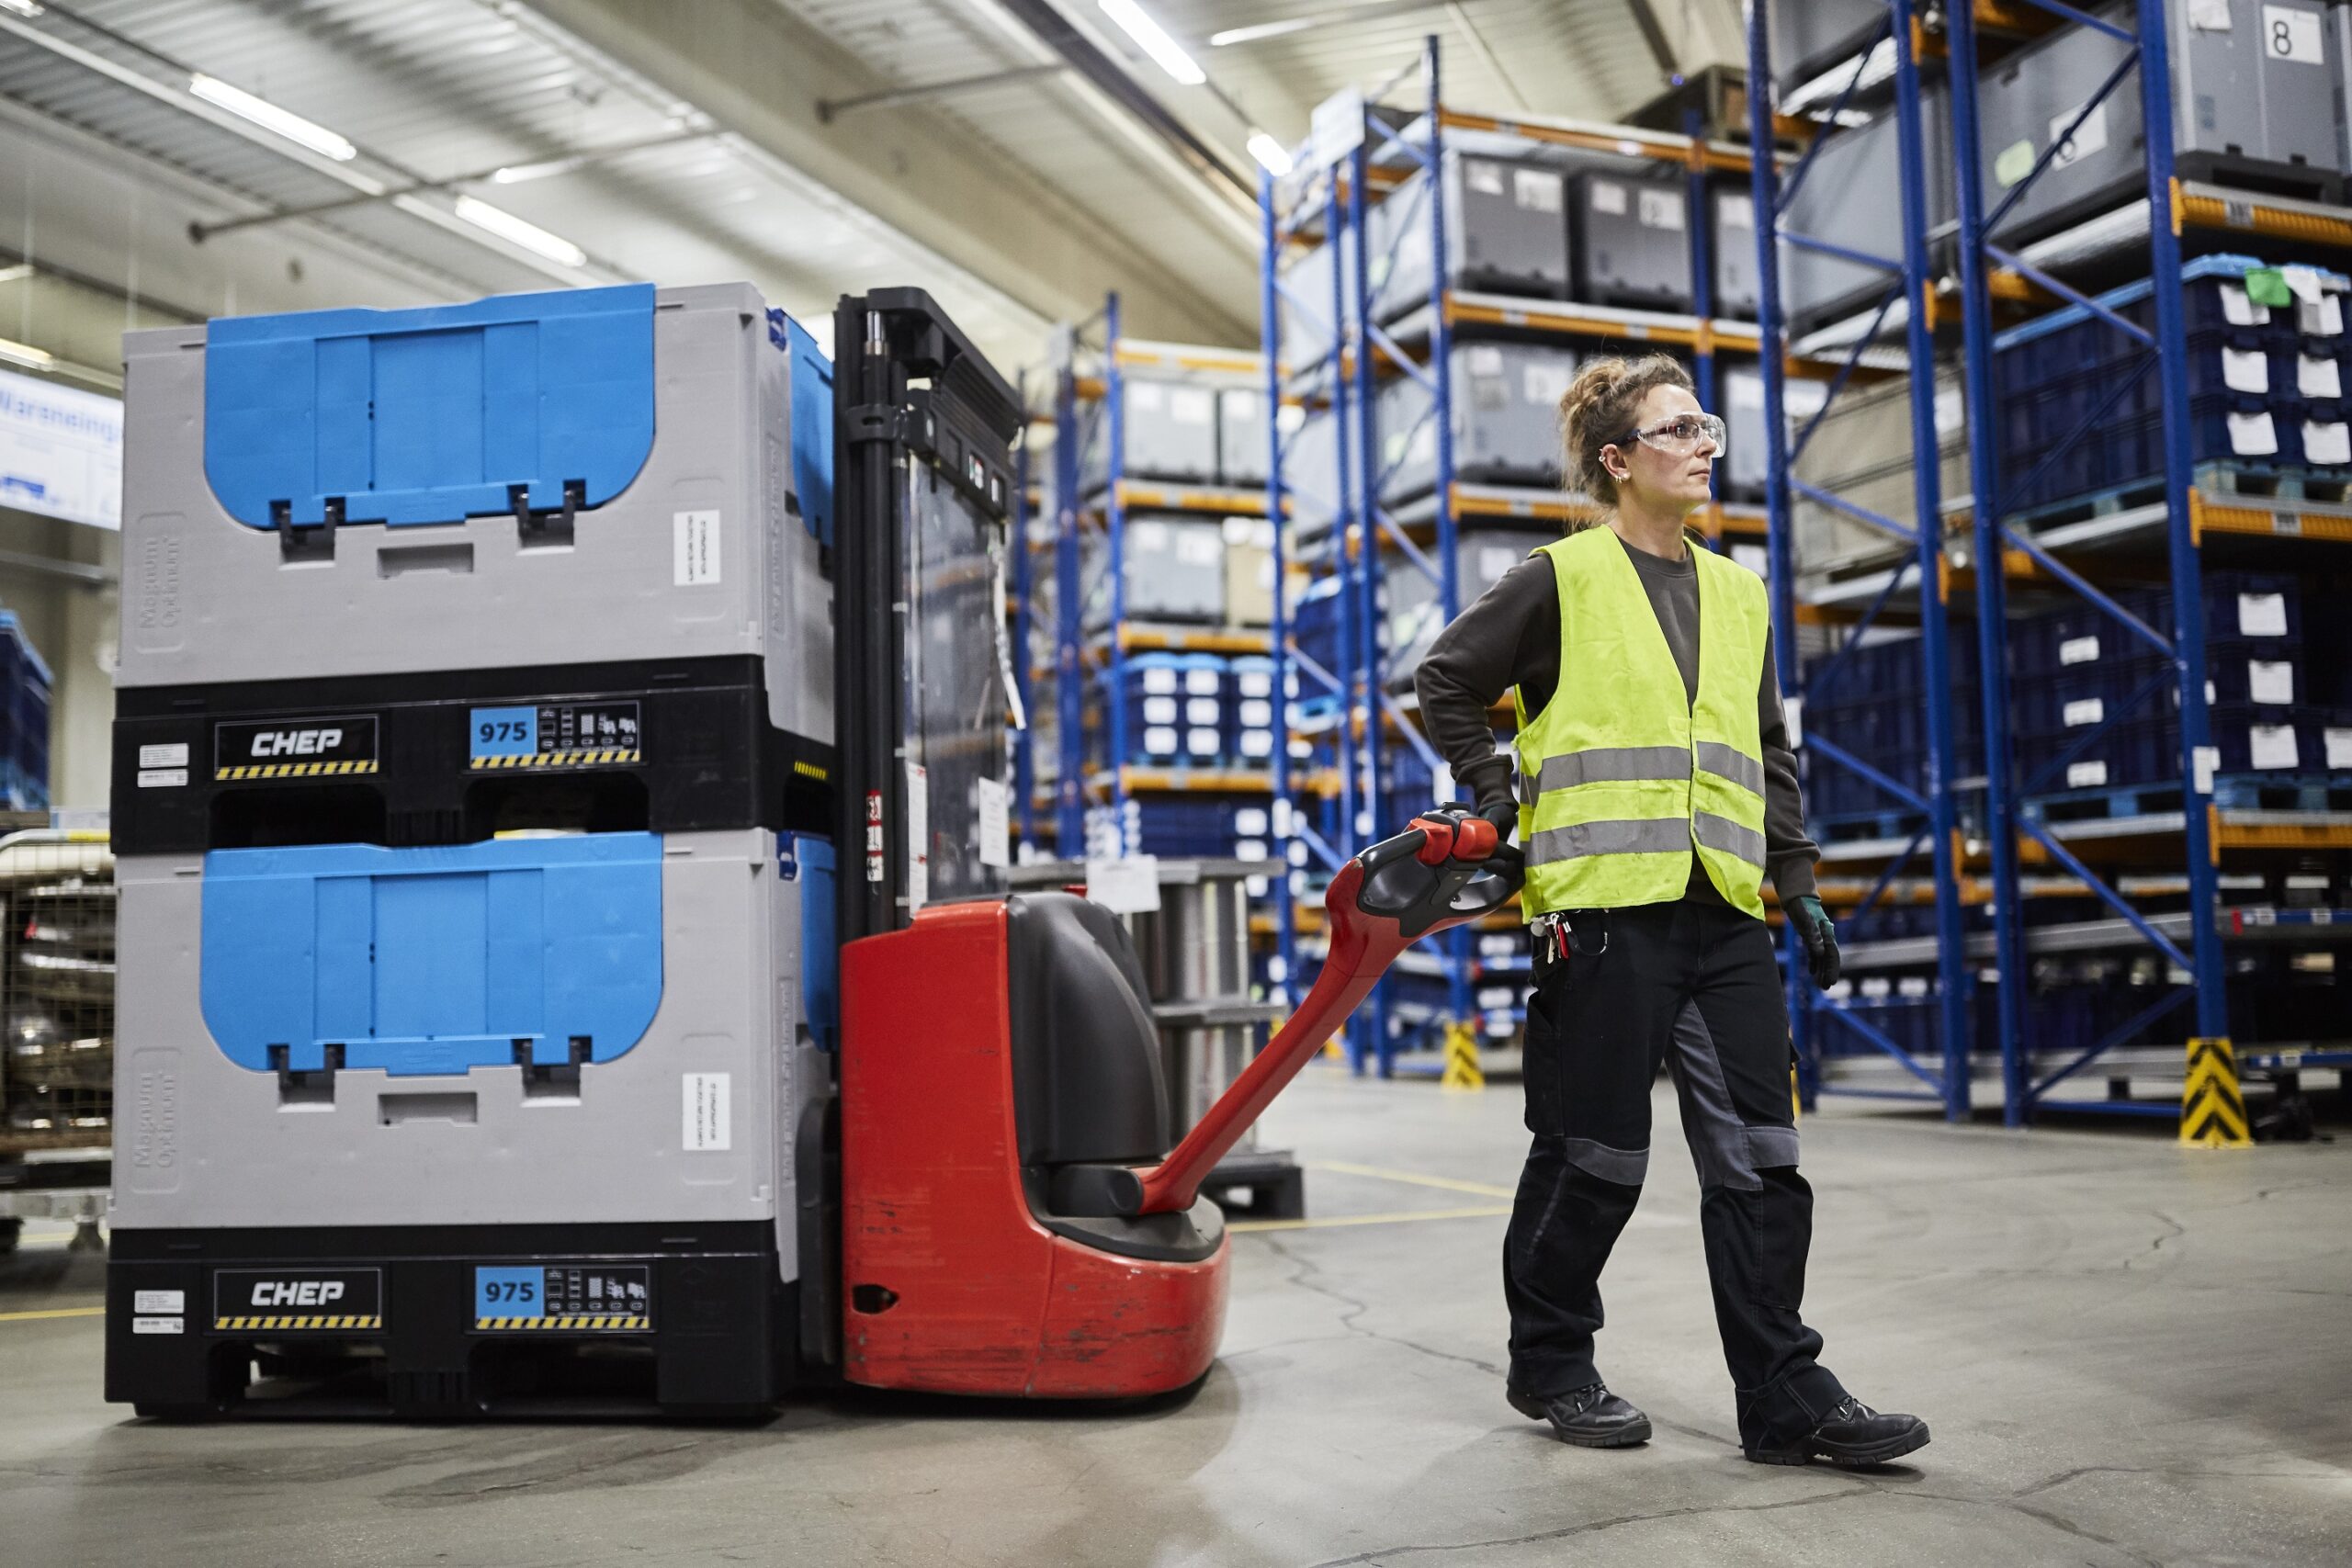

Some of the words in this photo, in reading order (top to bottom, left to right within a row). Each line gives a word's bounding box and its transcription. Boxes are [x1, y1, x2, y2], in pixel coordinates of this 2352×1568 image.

[2273, 20, 2292, 55] 8
[251, 728, 343, 757] CHEP
[480, 721, 527, 743] 975
[251, 1281, 345, 1306] CHEP
[485, 1282, 534, 1303] 975
